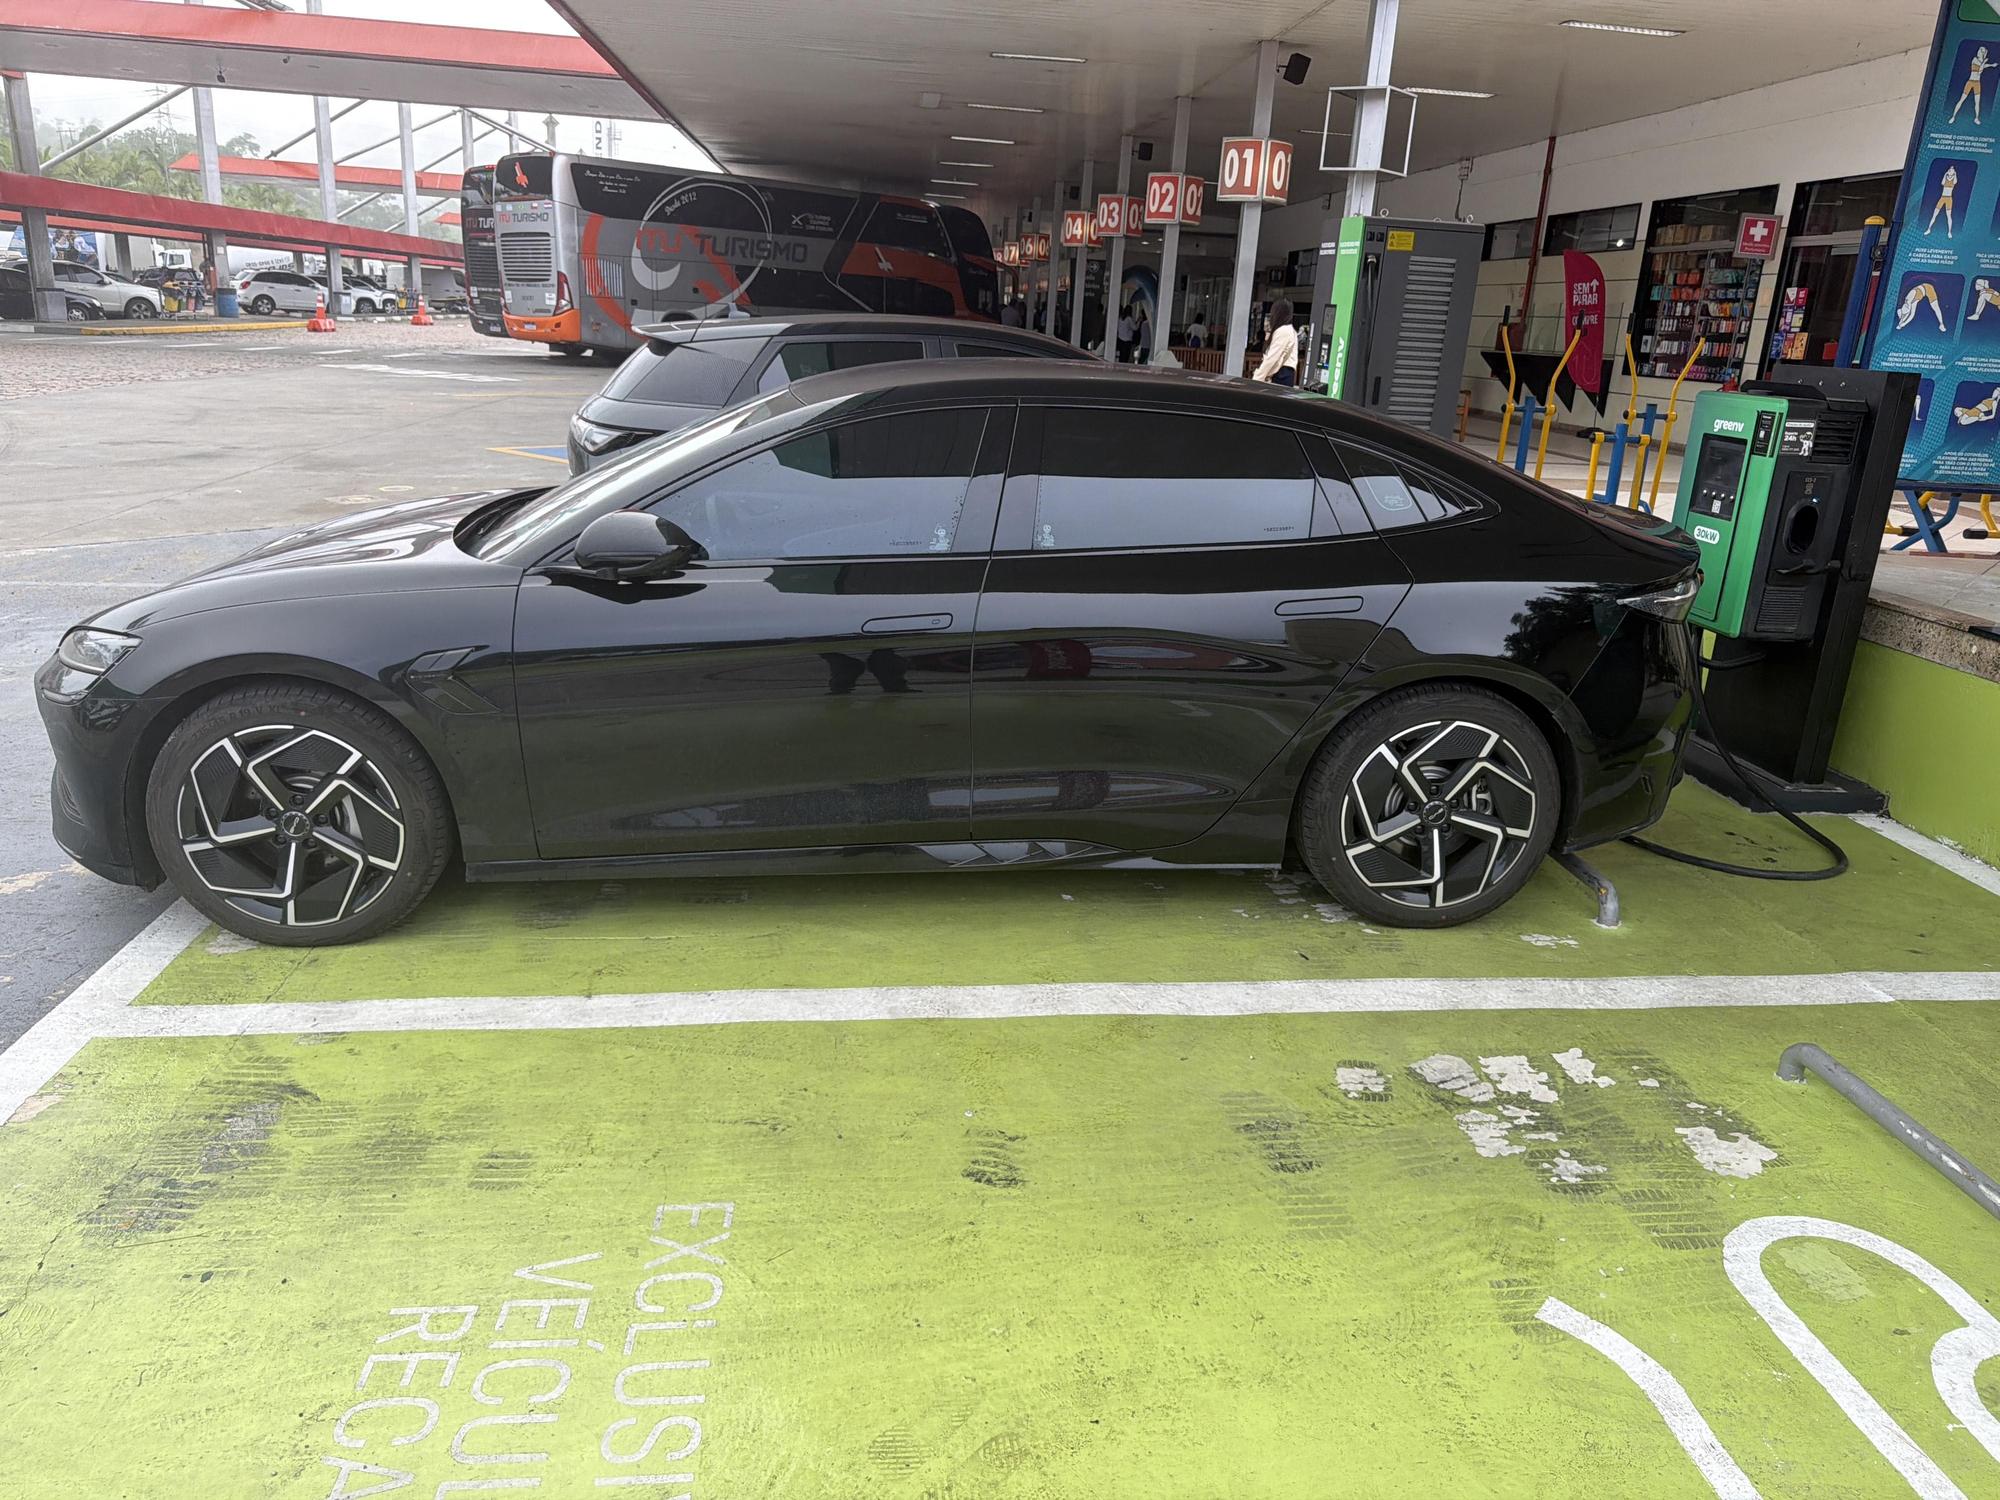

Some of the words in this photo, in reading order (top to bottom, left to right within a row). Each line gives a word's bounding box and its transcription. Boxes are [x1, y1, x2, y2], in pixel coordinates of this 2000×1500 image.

[1224, 148, 1255, 189] 01
[1149, 181, 1175, 213] 02
[512, 212, 549, 222] TURISMO
[1100, 201, 1120, 228] 03
[1065, 217, 1082, 240] 04
[695, 233, 808, 263] TURISMO
[1004, 244, 1016, 262] 07
[1021, 238, 1033, 255] 06
[1574, 282, 1590, 295] SEM
[1573, 294, 1598, 306] PARAR
[1714, 419, 1744, 432] greenv
[1696, 528, 1718, 541] 30kW
[594, 1201, 735, 1500] EXCLUSI
